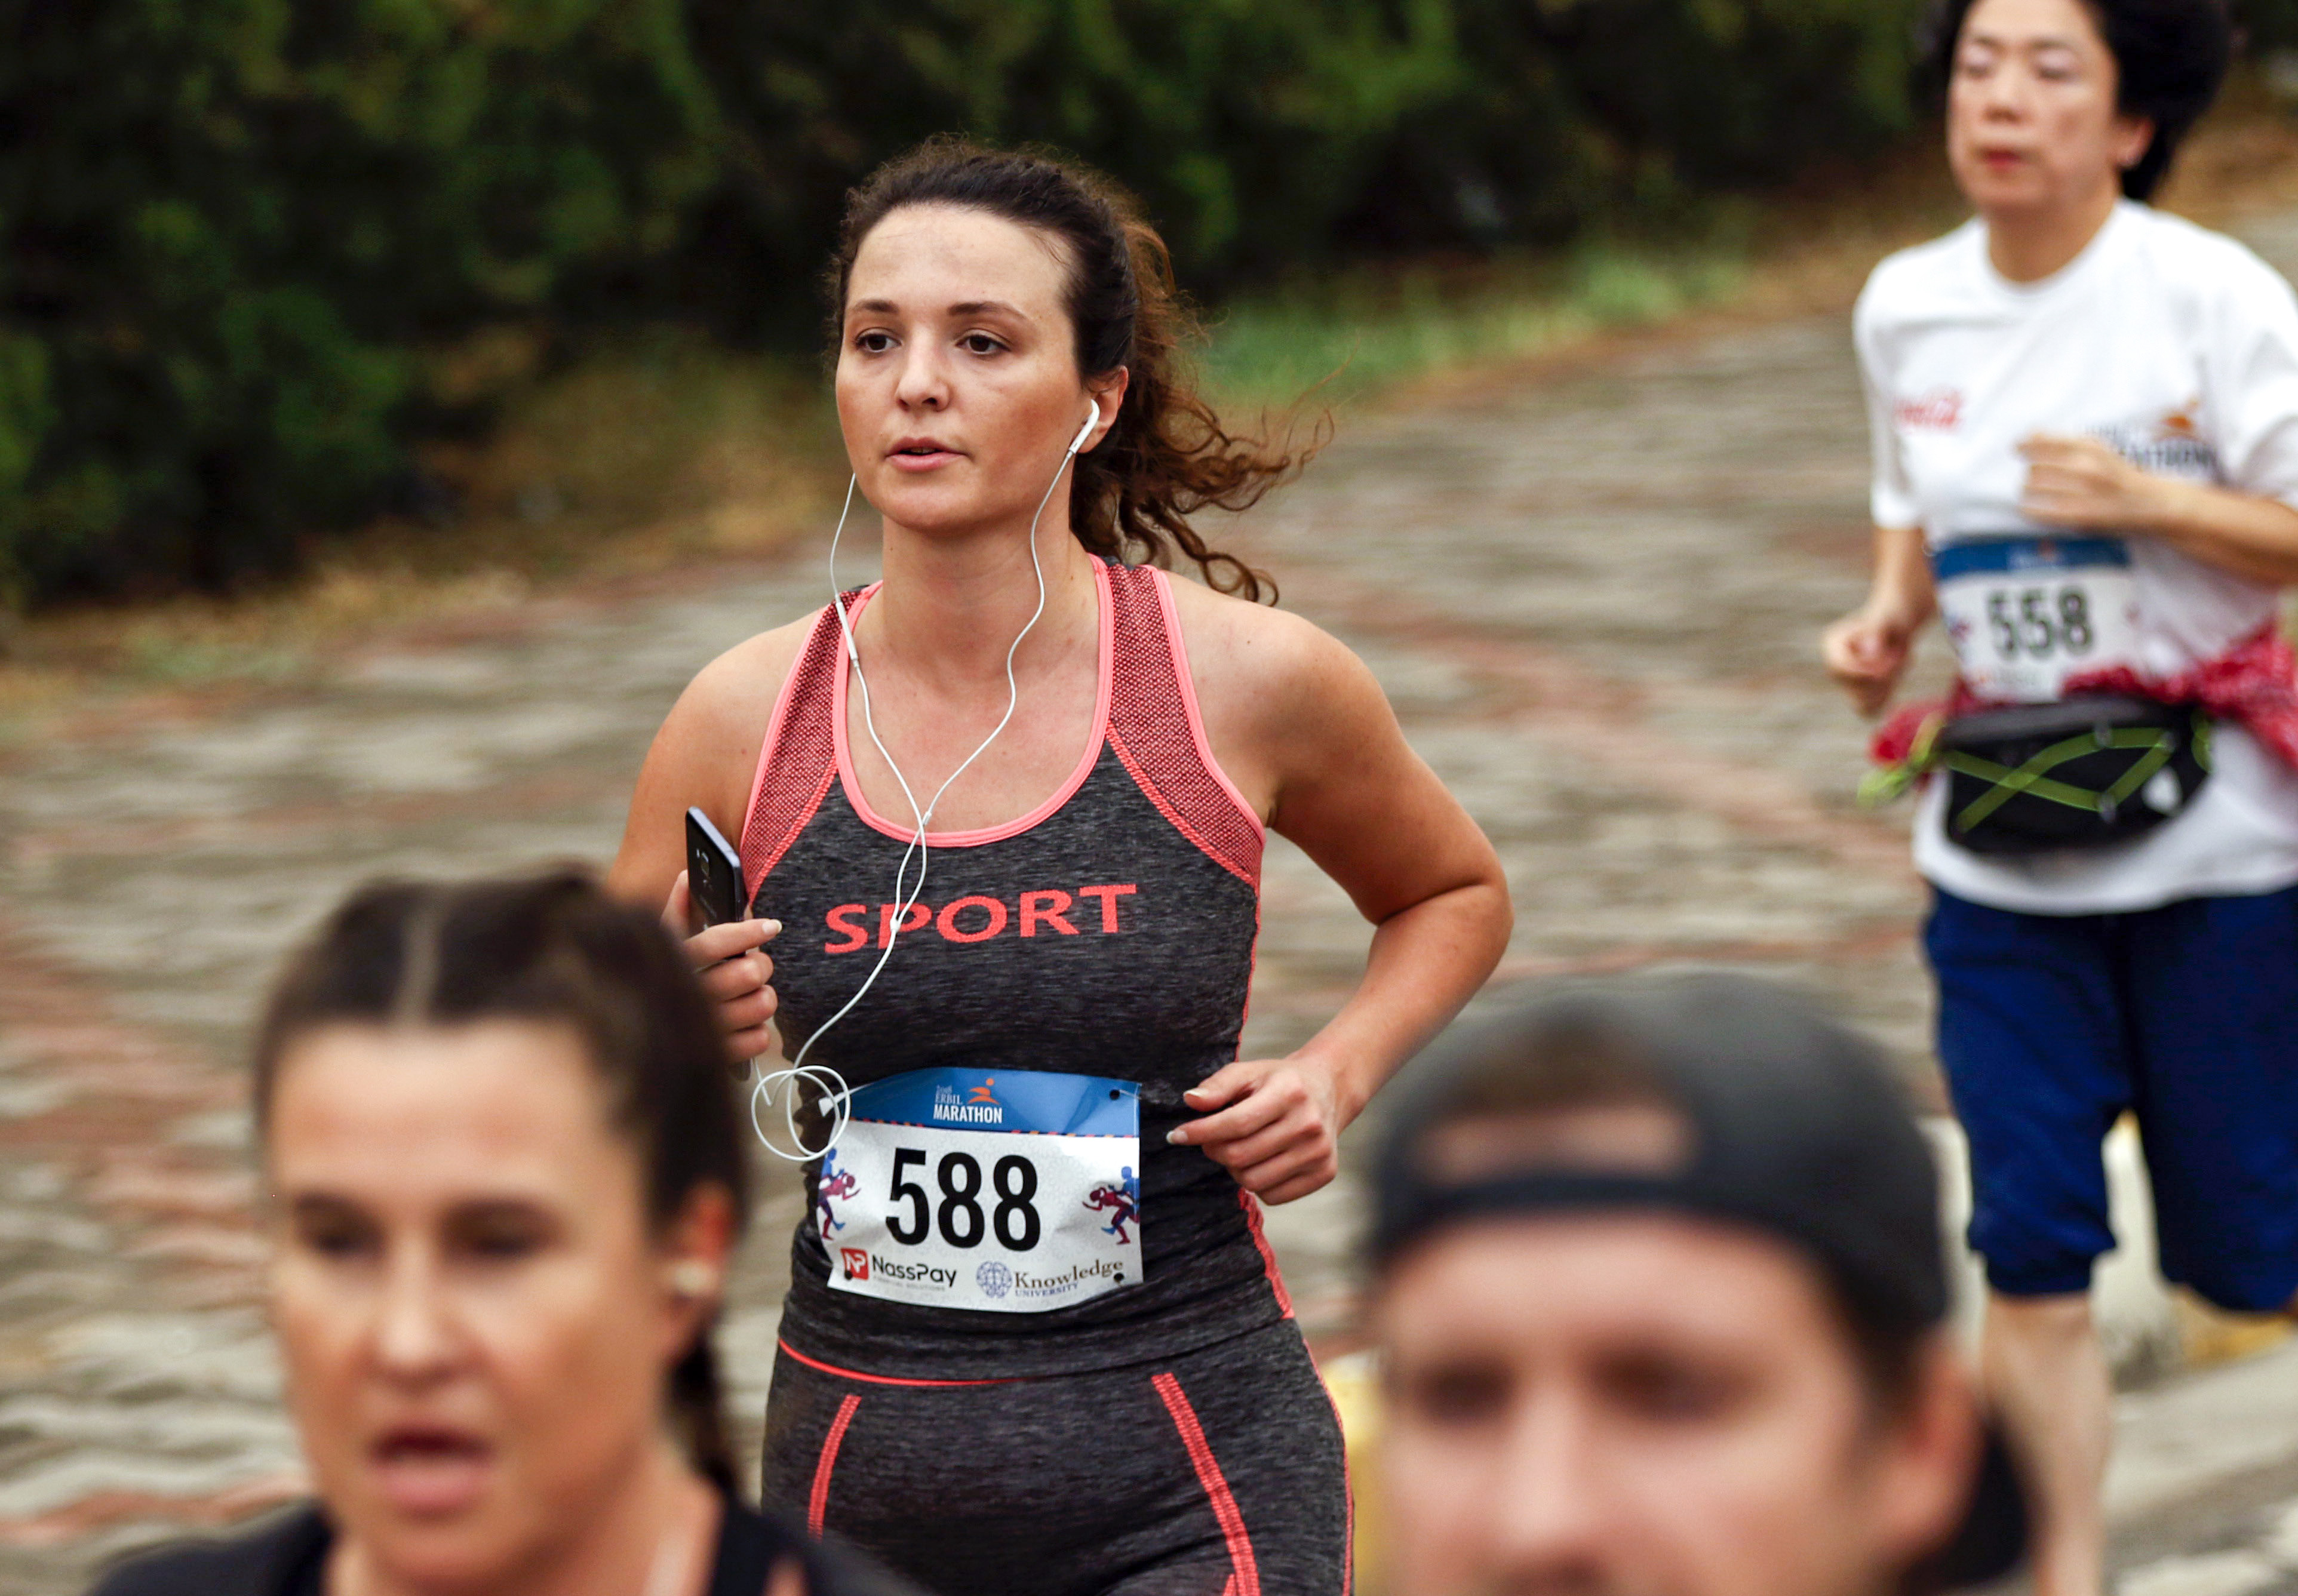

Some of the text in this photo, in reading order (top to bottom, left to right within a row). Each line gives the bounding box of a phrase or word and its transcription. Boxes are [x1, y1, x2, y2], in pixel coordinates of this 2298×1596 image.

[1987, 588, 2093, 659] 558
[824, 884, 1137, 954] SPORT
[933, 1103, 1003, 1124] MARATHON
[935, 1093, 963, 1105] ERBIL
[886, 1147, 1041, 1251] 588
[872, 1254, 957, 1288] NassPay
[1015, 1259, 1123, 1289] Knowledge
[1015, 1283, 1078, 1297] UNIVERSITY
